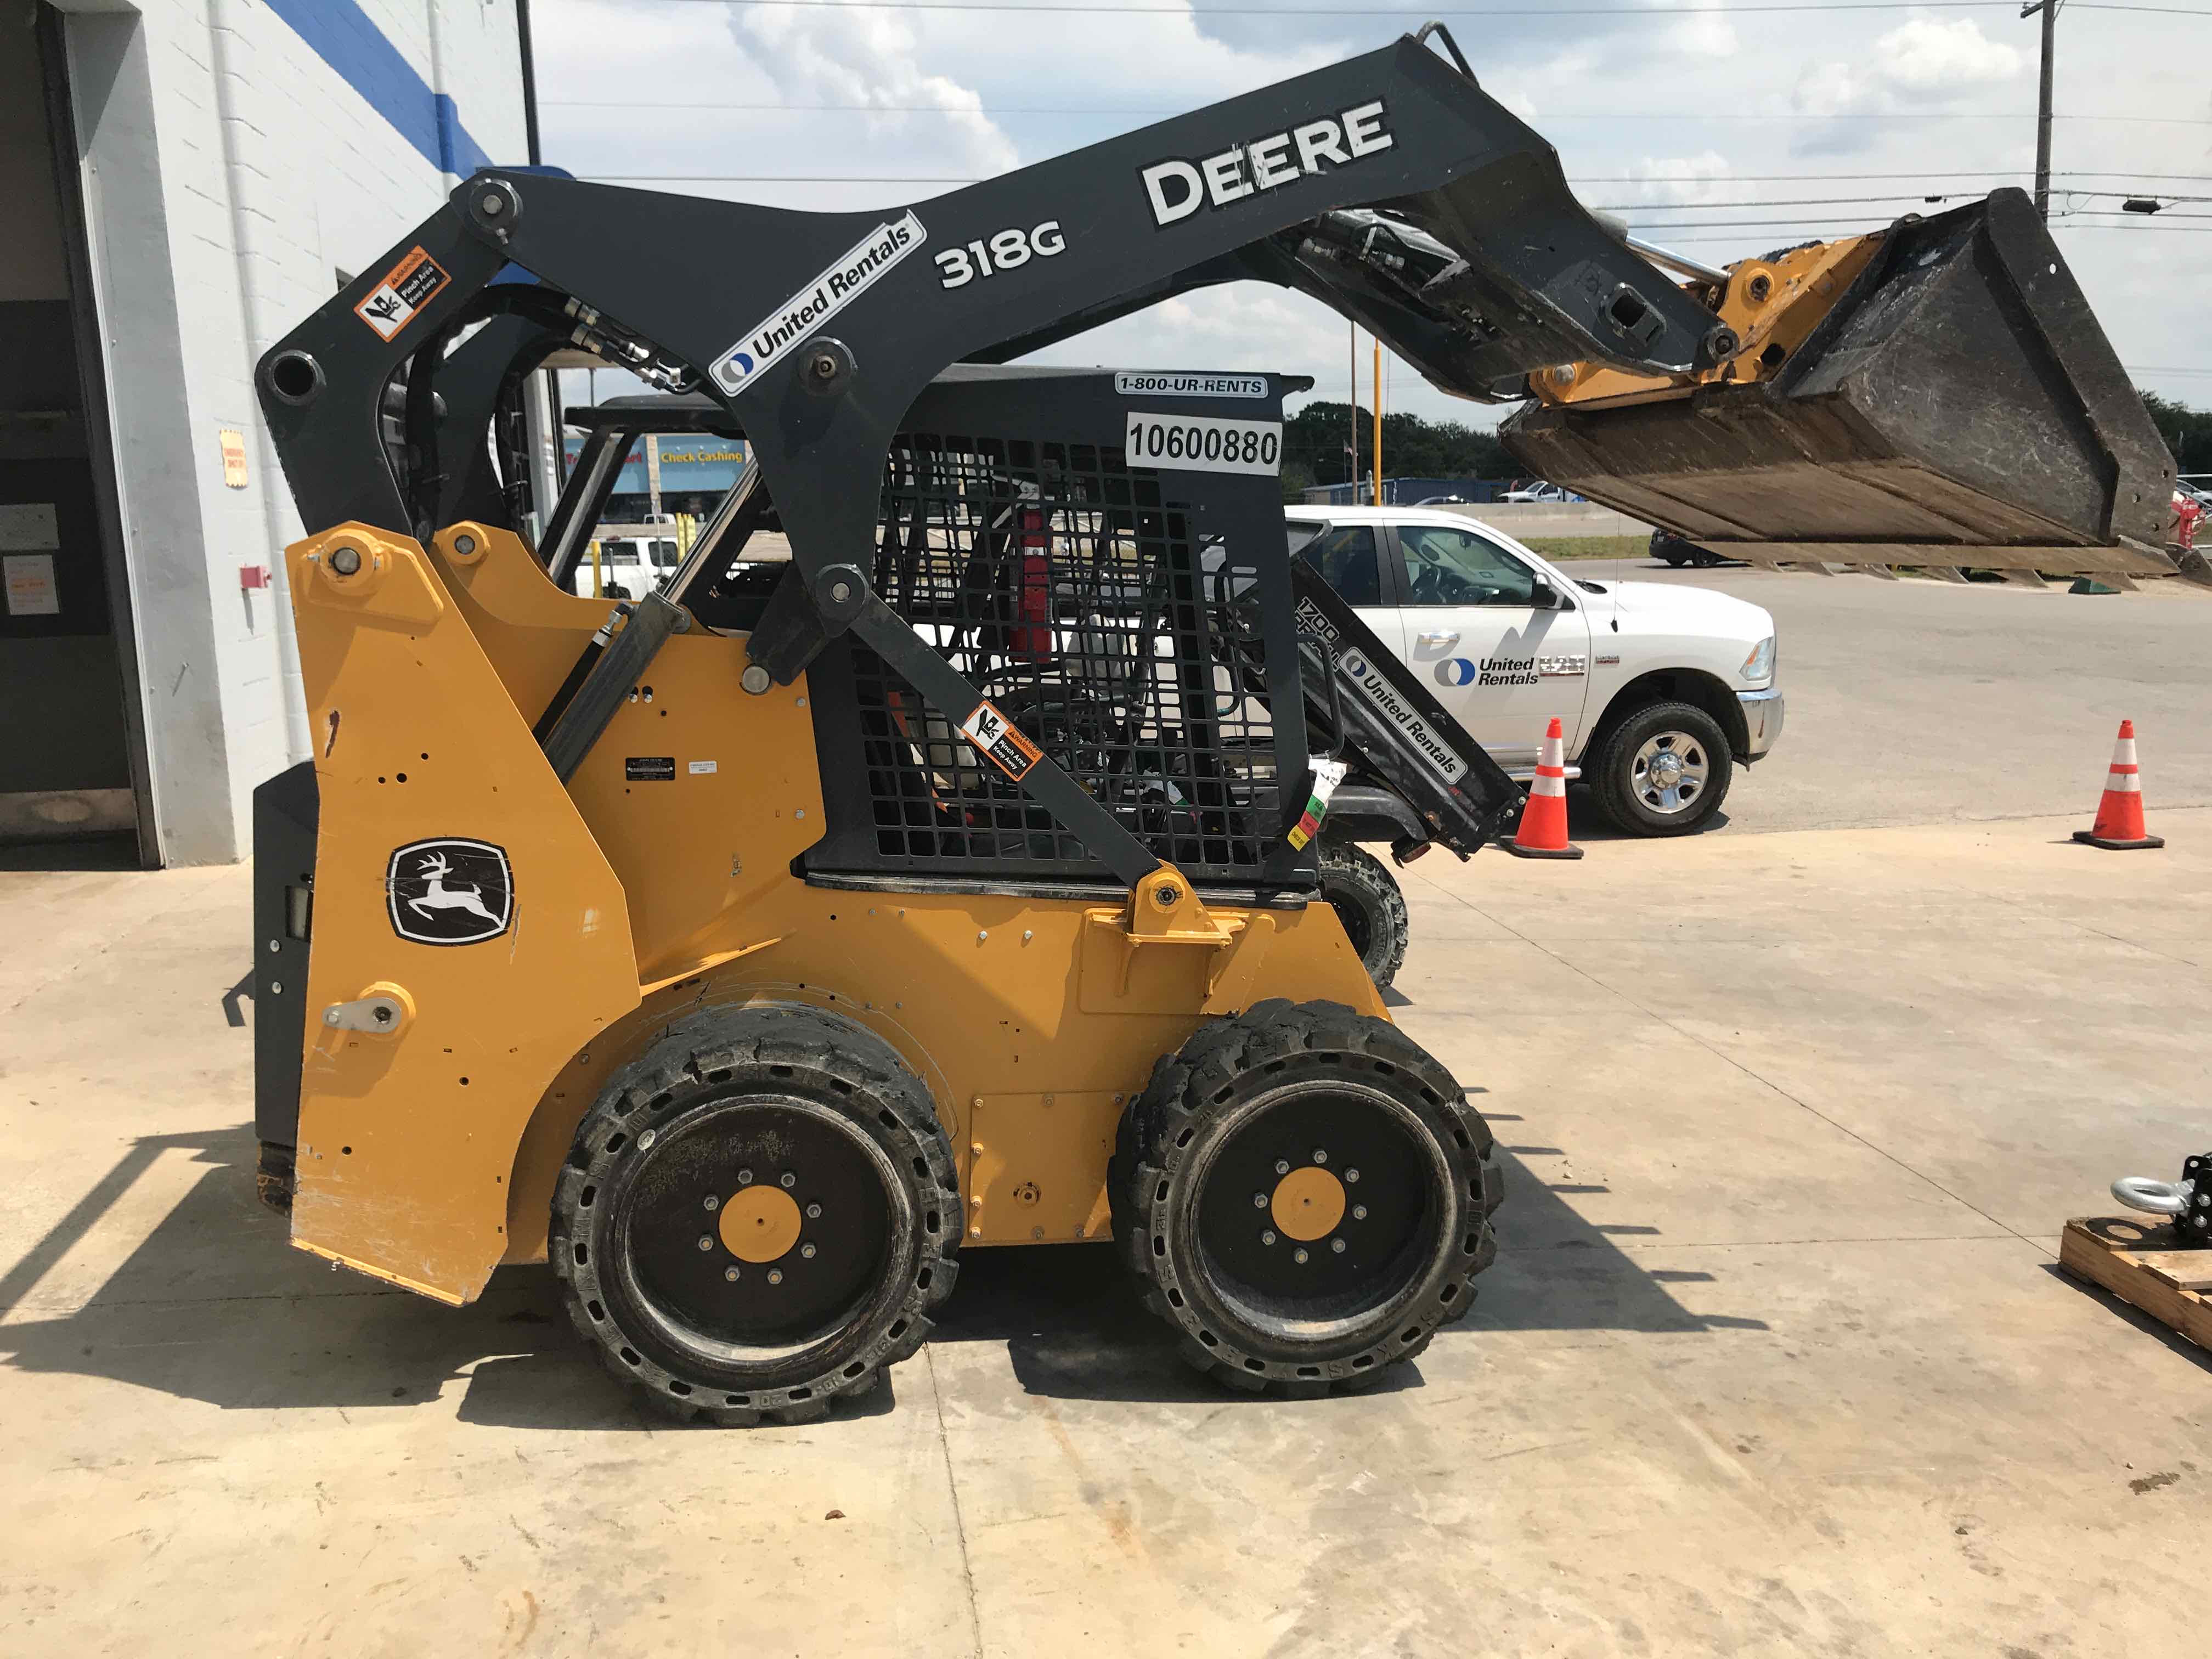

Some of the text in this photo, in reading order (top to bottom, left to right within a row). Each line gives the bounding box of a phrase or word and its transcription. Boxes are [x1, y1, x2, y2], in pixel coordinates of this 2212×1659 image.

[1142, 100, 1393, 225] DEERE
[934, 221, 1066, 289] 318G
[401, 266, 434, 298] Pinch Area
[753, 225, 911, 359] United Rentals
[1120, 377, 1262, 393] 1-800-UR-RENTS
[661, 451, 742, 463] Check Cashing
[1130, 422, 1278, 465] 10600880
[1297, 596, 1340, 644] 1700
[1478, 672, 1538, 686] Rentals
[1479, 657, 1535, 671] United
[1363, 674, 1457, 774] United Rentals
[993, 746, 1018, 770] Keep Away
[998, 740, 1027, 768] Pinch Area
[1014, 734, 1037, 758] WARNING
